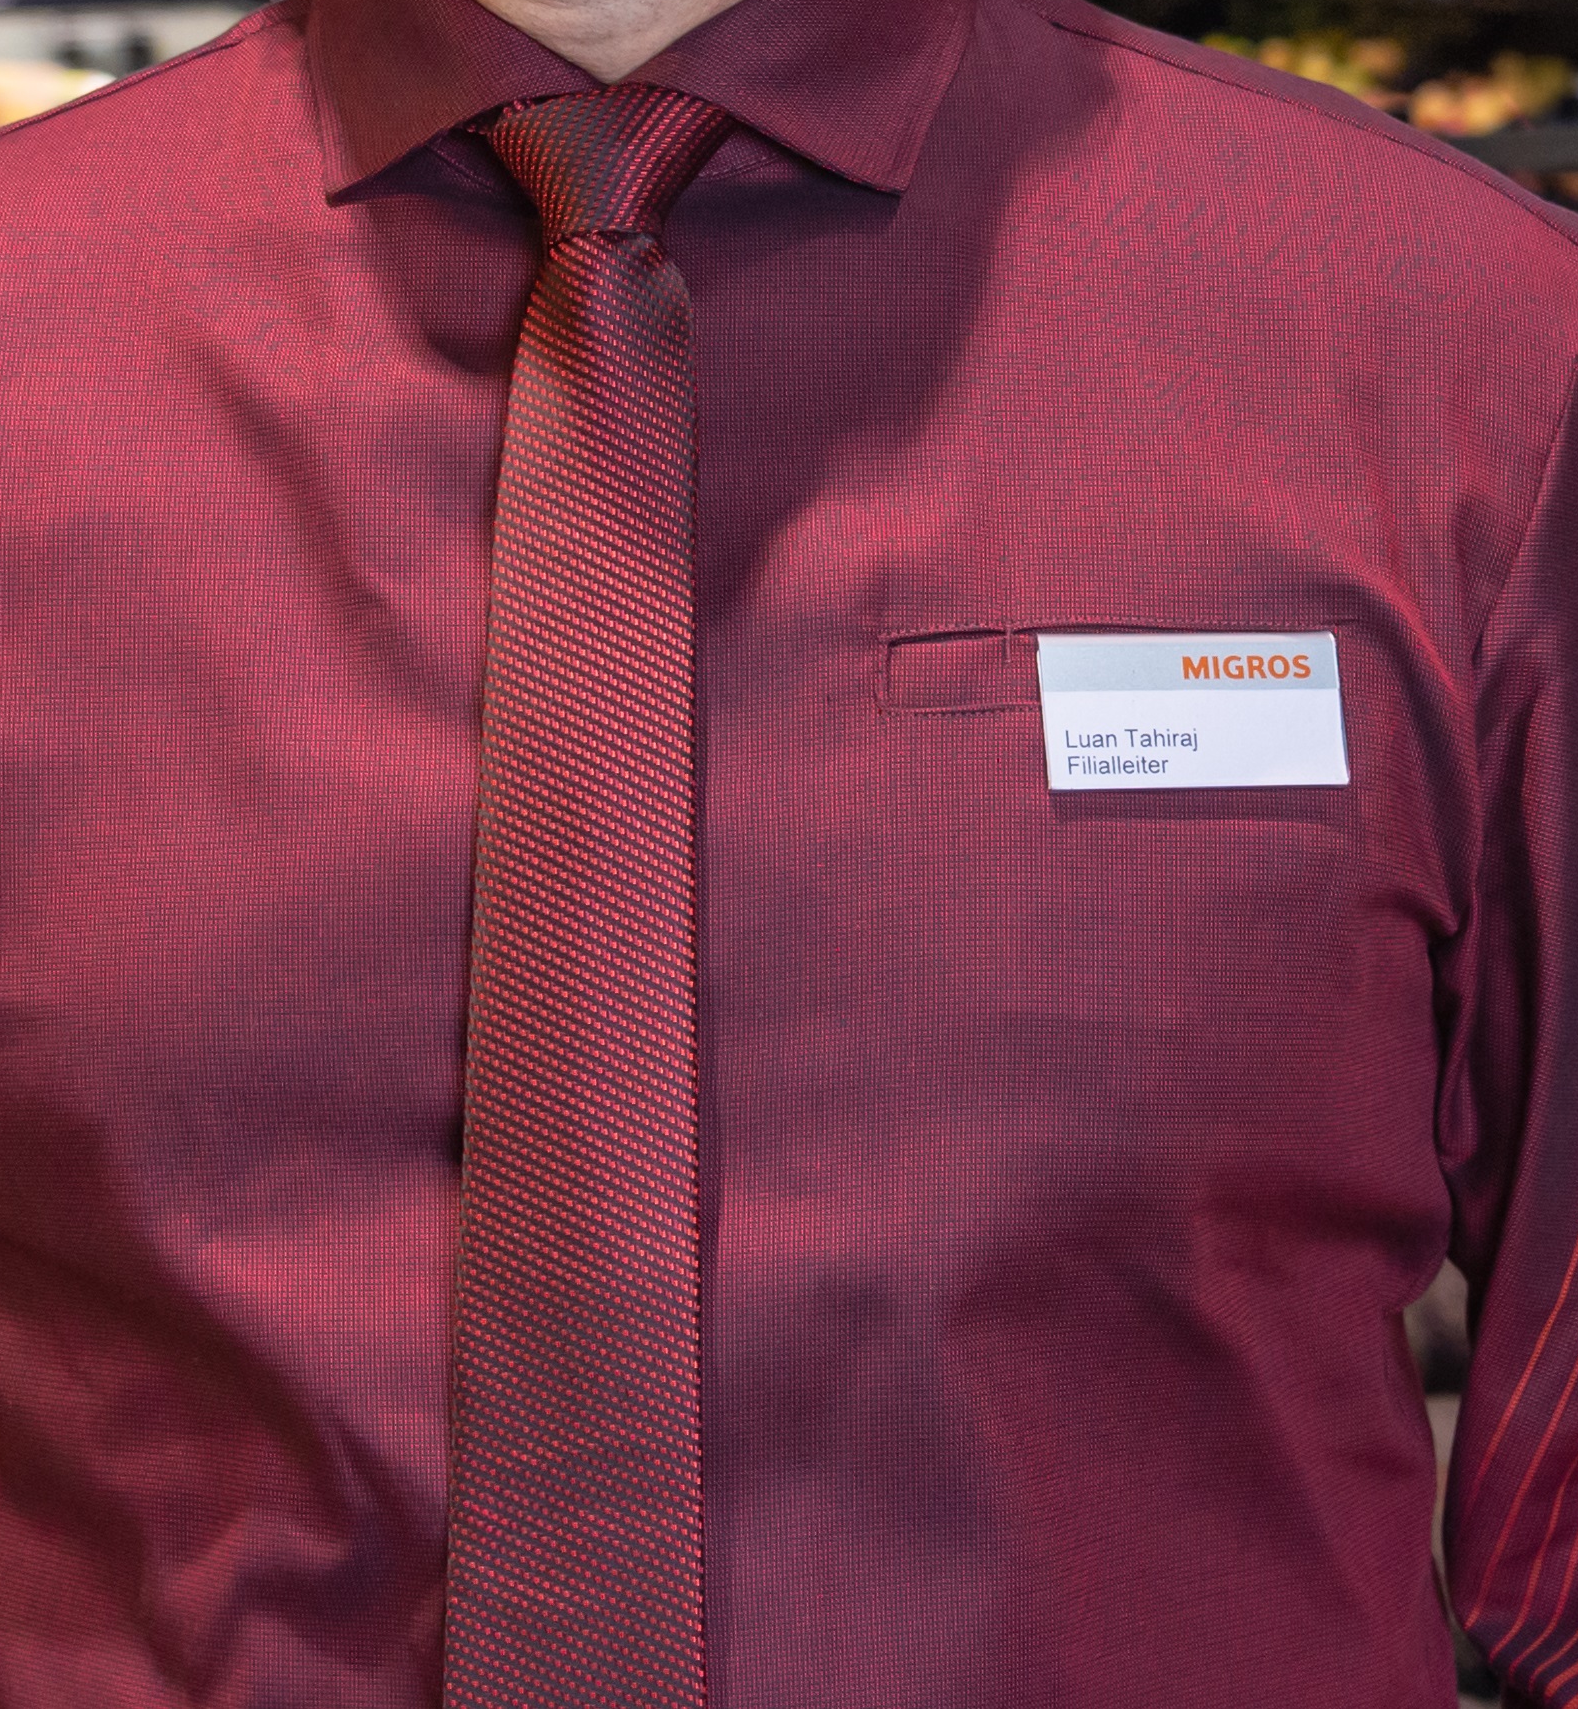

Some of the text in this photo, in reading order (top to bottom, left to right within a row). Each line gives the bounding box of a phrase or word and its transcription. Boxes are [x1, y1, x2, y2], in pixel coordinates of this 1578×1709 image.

[1181, 654, 1312, 681] MIGROS
[1064, 728, 1199, 752] Luan Tahiraj
[1066, 755, 1170, 776] Filialleiter
